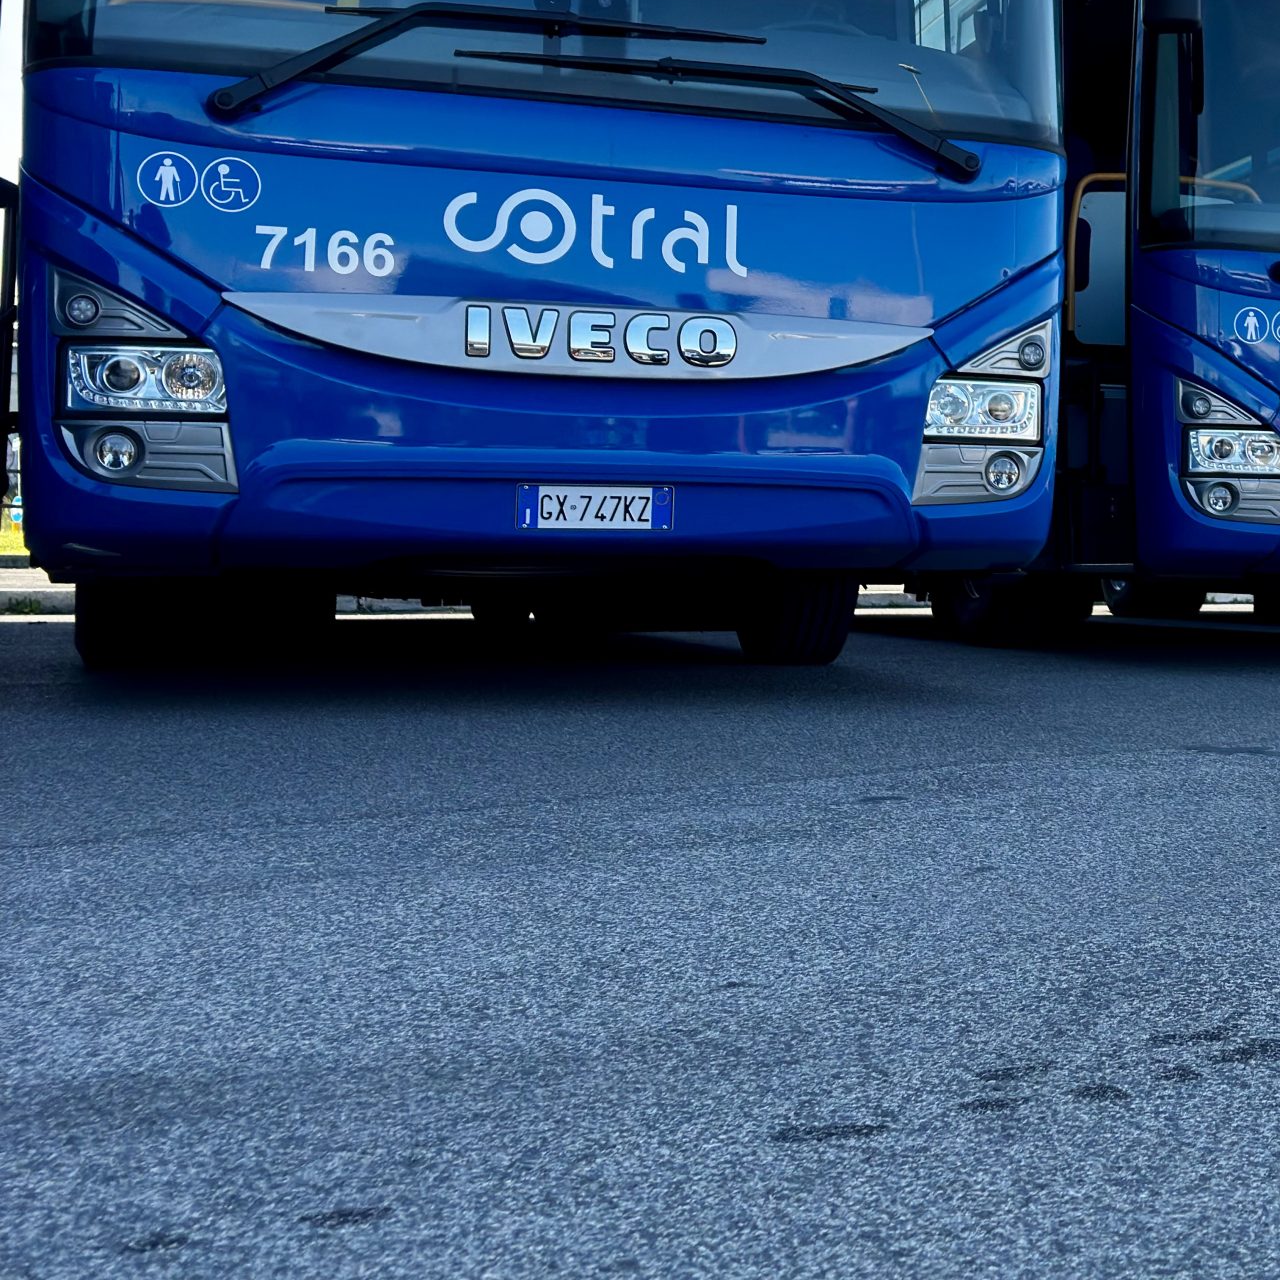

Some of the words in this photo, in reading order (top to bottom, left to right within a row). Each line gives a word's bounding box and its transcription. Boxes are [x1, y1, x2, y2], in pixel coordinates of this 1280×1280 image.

[255, 225, 395, 277] 7166
[443, 188, 748, 278] cotral
[465, 304, 738, 368] IVECO
